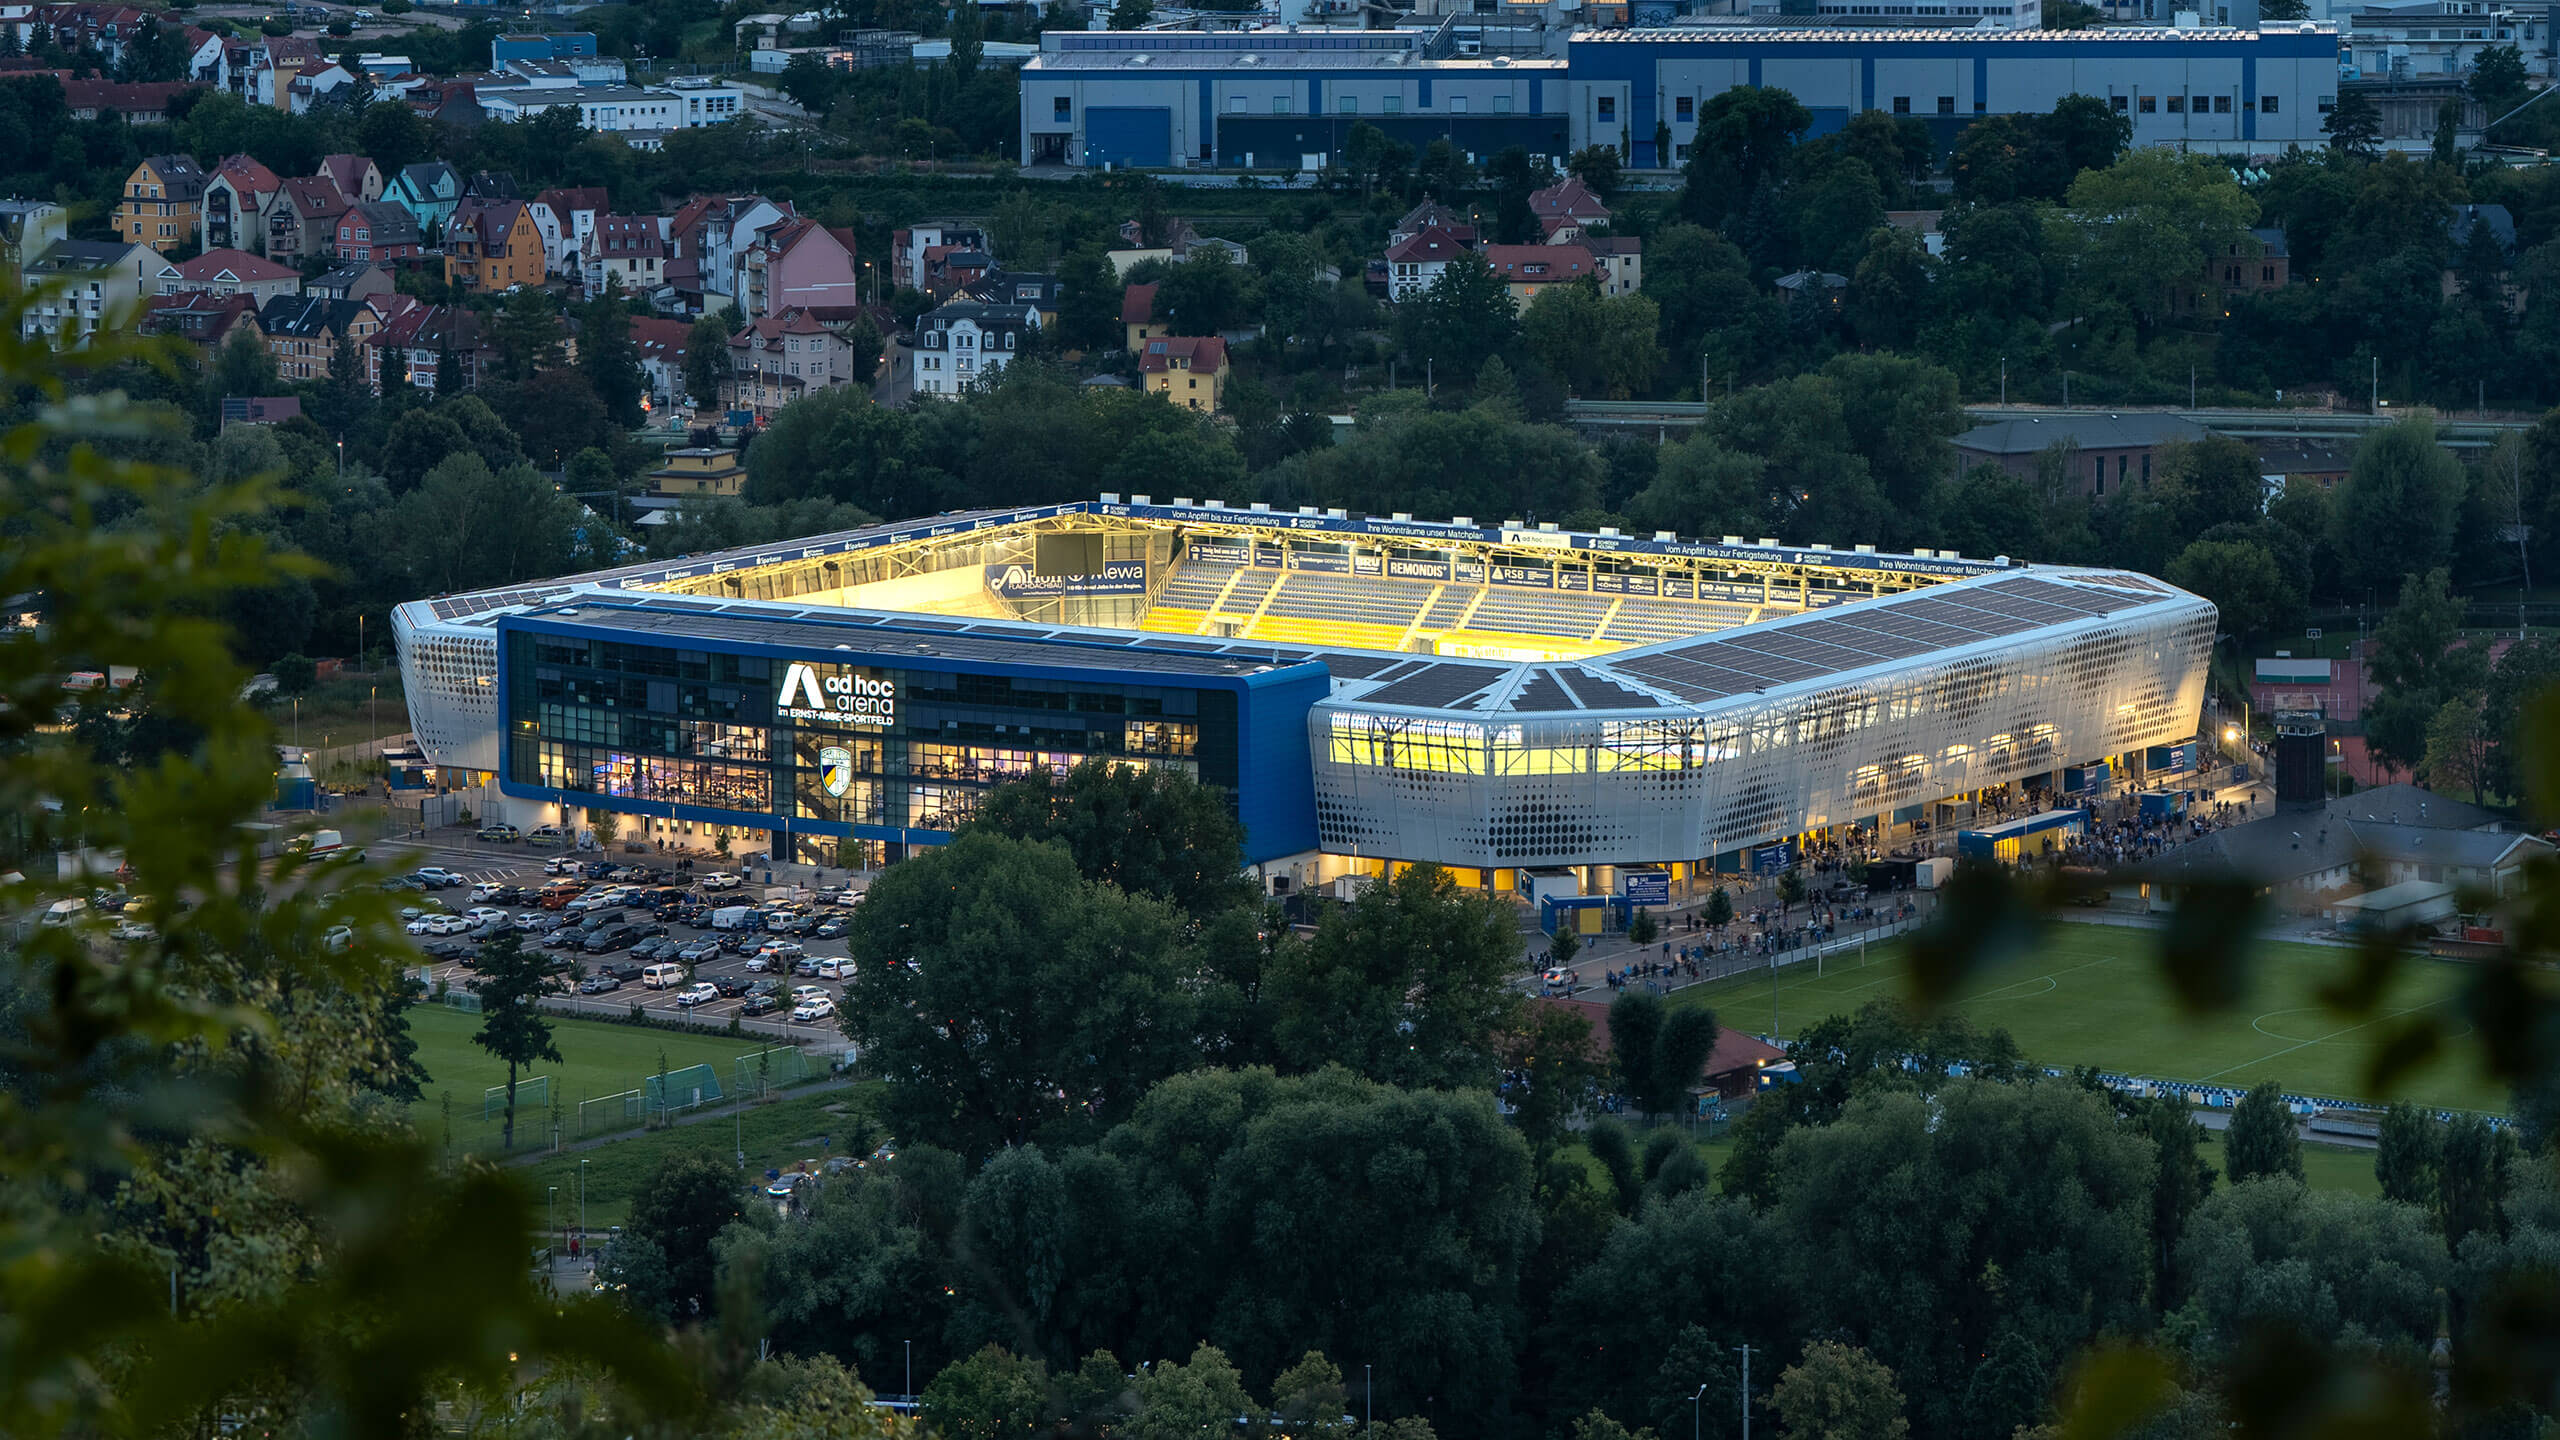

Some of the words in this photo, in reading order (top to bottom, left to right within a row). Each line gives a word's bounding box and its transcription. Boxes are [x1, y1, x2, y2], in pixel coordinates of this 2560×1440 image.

[1172, 510, 1186, 519] Vom
[1187, 511, 1210, 522] Anpfiff
[1211, 513, 1221, 522] bis
[1222, 515, 1233, 523] zur
[1234, 512, 1280, 527] Fertigstellung
[935, 527, 955, 536] Sparkasse
[1367, 524, 1381, 533] Ihre
[1382, 524, 1426, 537] Wohnträume
[1426, 529, 1446, 538] unser
[1447, 529, 1484, 540] Matchplan
[849, 541, 870, 550] Sparkasse
[761, 555, 782, 565] Sparkasse
[1664, 545, 1680, 554] Vom
[1681, 546, 1706, 557] Anpfiff
[1707, 548, 1719, 557] bis
[1719, 550, 1731, 558] zur
[1732, 549, 1782, 563] Fertigstellung
[1504, 569, 1524, 580] RSB
[1879, 560, 1893, 569] Ihre
[1894, 560, 1942, 573] Wohnträume
[1943, 565, 1964, 574] unser
[670, 571, 692, 580] Sparkasse
[825, 673, 852, 694] ad
[854, 674, 895, 698] hoc
[836, 694, 894, 715] arena
[777, 707, 789, 717] im
[790, 708, 894, 727] ERNST-ABBE-SPORTFELD
